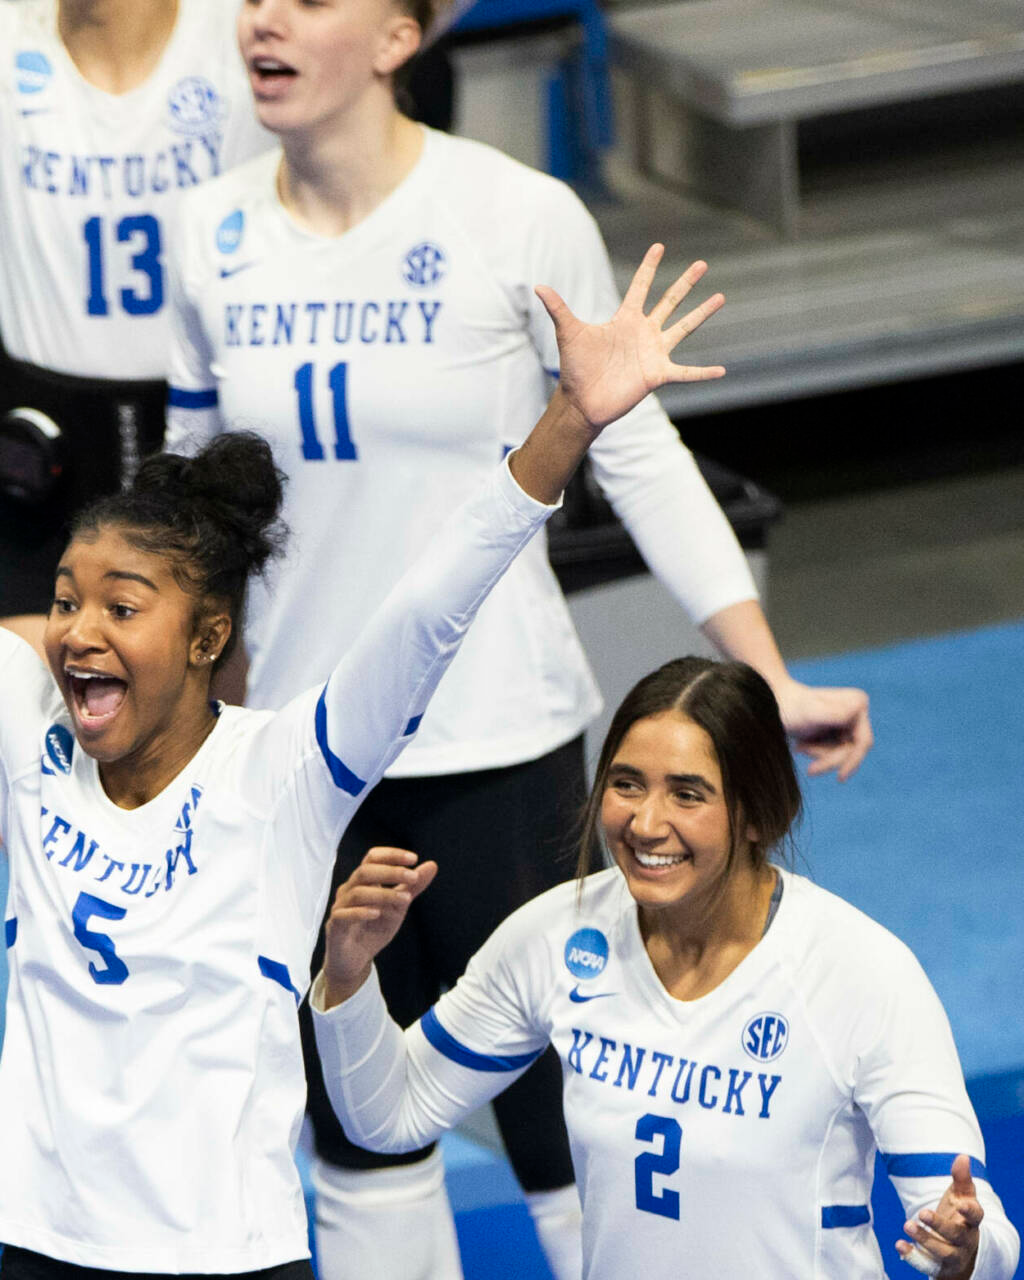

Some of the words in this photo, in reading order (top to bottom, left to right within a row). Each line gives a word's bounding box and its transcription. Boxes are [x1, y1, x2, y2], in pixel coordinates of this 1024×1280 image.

[83, 212, 167, 318] 13
[225, 300, 441, 347] KENTUCKY
[293, 360, 360, 462] 11
[71, 890, 129, 986] 5
[568, 947, 605, 970] NCAA
[567, 1027, 783, 1120] KENTUCKY
[746, 1015, 787, 1060] SEC
[634, 1112, 683, 1222] 2
